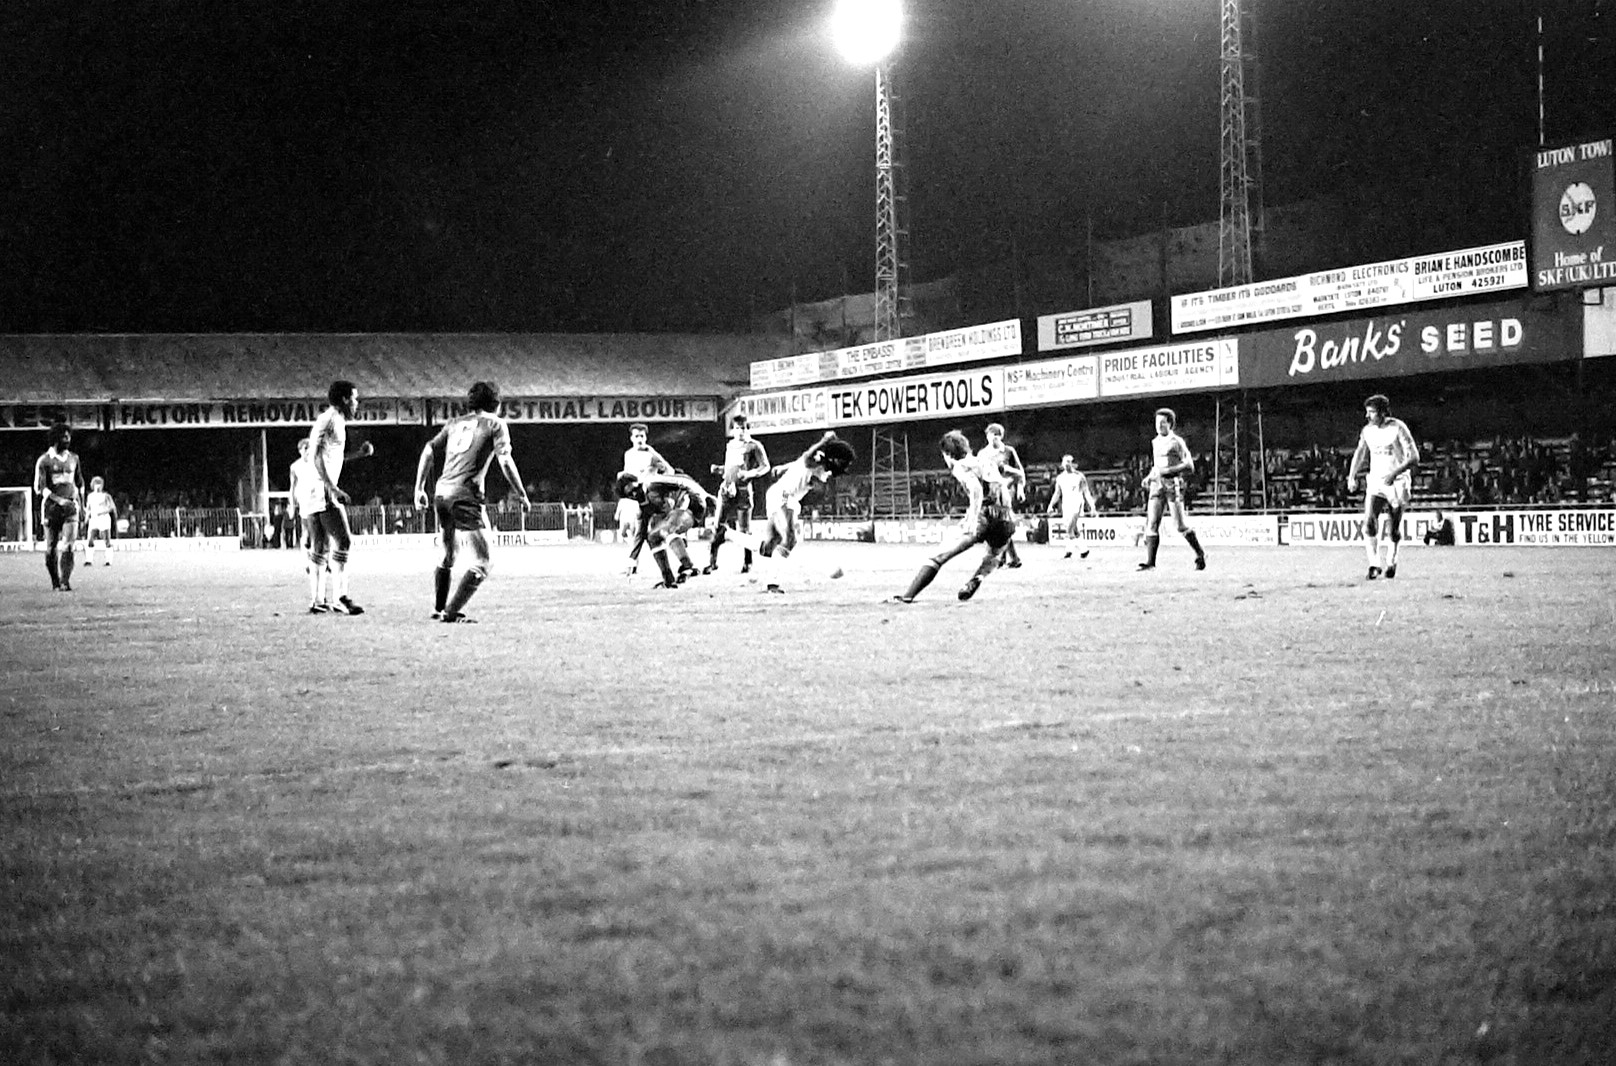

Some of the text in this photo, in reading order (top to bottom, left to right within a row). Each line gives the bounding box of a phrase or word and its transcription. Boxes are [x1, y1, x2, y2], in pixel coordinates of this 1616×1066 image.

[1537, 145, 1575, 168] LUTON
[1414, 258, 1444, 276] BRIAN
[1454, 245, 1526, 270] HANDSCOMBE
[1554, 246, 1603, 268] Home of
[1352, 261, 1409, 280] ELECTRONICS
[1538, 268, 1563, 286] SKF
[1593, 261, 1616, 279] LTD
[1433, 274, 1505, 293] LUTON 425921
[1288, 320, 1405, 376] Banks'
[1421, 318, 1523, 353] SEED
[1104, 355, 1138, 373] PRIDE
[1142, 346, 1215, 368] FACILITIES
[1184, 365, 1215, 375] AGENCY
[831, 390, 863, 420] TEK
[868, 383, 929, 417] POWER
[930, 374, 993, 411] TOOLS
[121, 403, 214, 425] FACTORY
[597, 400, 687, 419] LABOUR
[1073, 523, 1115, 541] imoco
[1318, 519, 1412, 541] VAUXAL
[1459, 513, 1615, 543] T&H TYRE SERVICE
[1519, 534, 1615, 543] FIND US IN THE YELLOW
